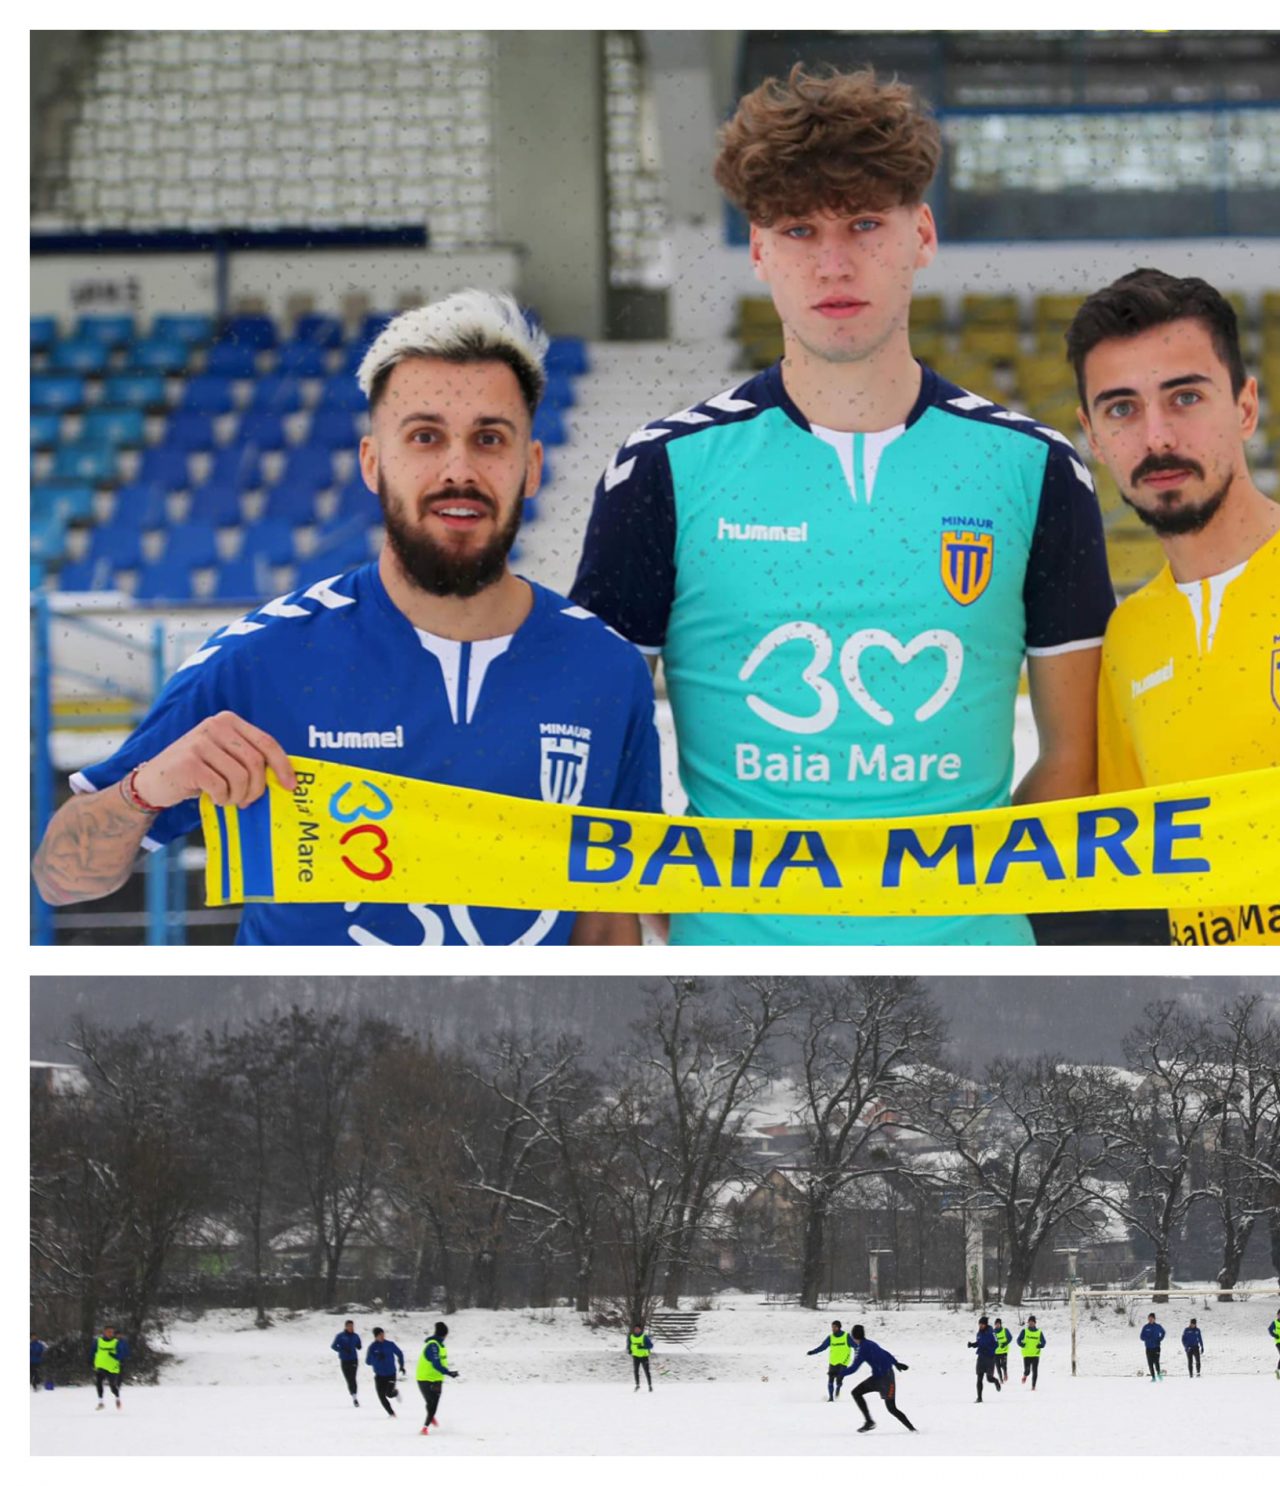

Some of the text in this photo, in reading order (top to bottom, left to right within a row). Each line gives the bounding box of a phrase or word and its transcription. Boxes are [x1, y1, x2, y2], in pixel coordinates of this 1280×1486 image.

[717, 517, 808, 542] hummel
[941, 516, 994, 529] MINAUR
[308, 725, 403, 748] hummel
[539, 723, 592, 740] MINAUR
[736, 743, 961, 782] Baia Mare
[298, 821, 320, 883] Mare
[567, 797, 1211, 889] BAIA MARE
